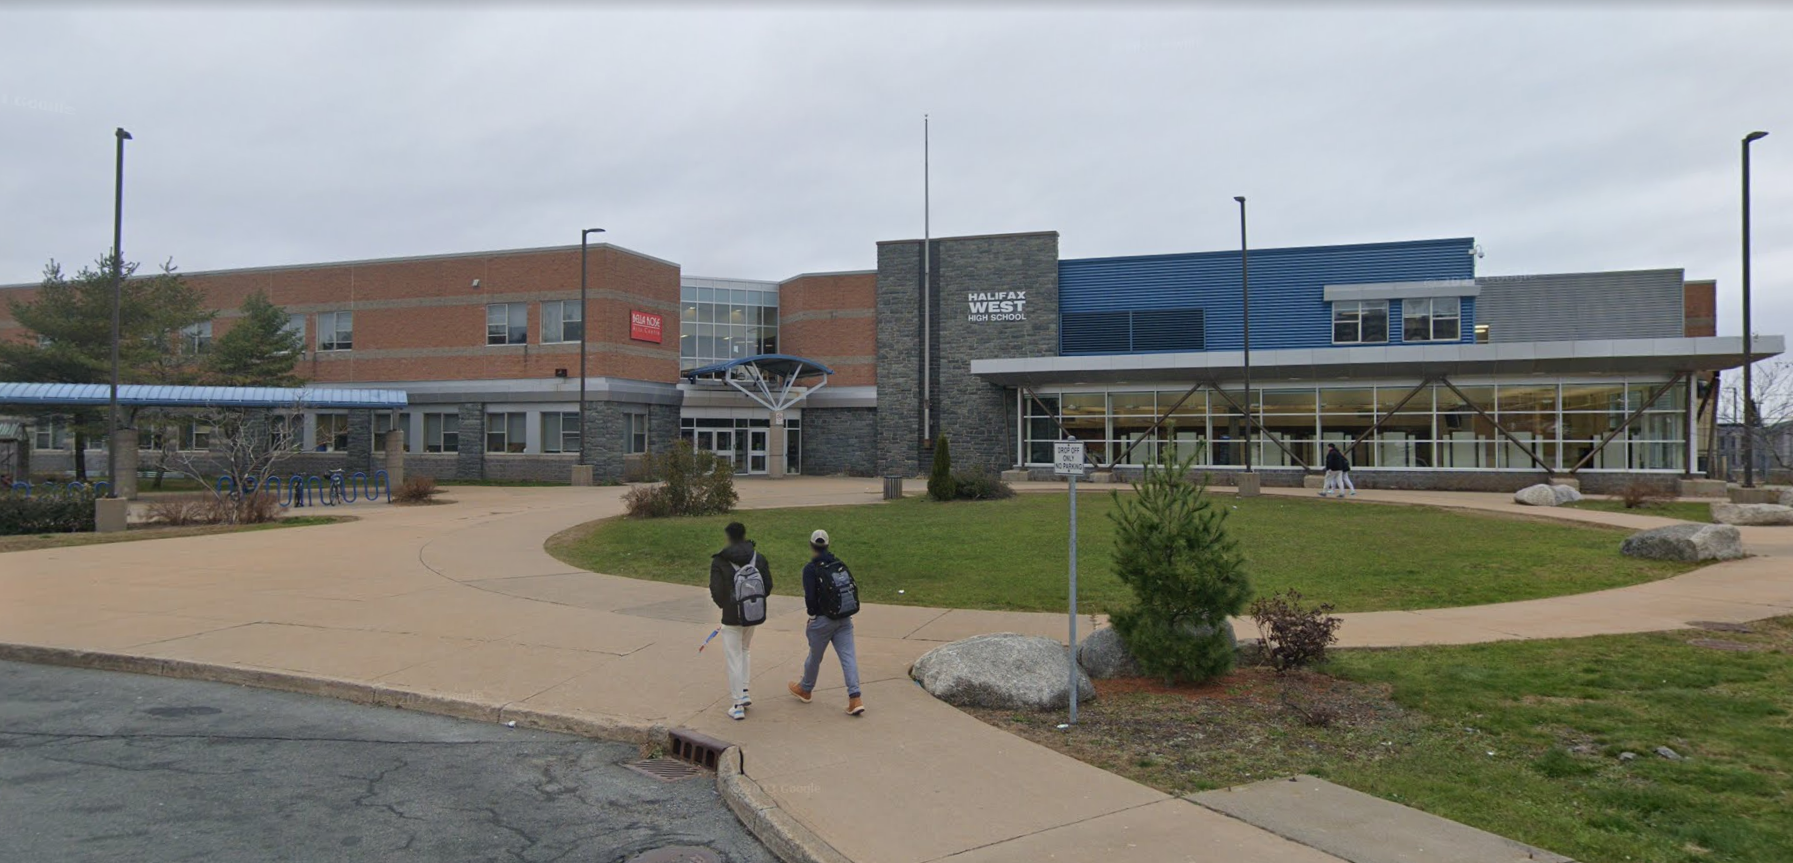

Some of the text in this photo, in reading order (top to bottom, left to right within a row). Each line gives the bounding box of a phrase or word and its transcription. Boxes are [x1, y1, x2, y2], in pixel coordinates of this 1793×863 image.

[968, 291, 1026, 301] HALIFAX
[968, 300, 1026, 313] WEST
[968, 313, 1026, 322] HIGH SCHOOL
[1057, 446, 1080, 454] DROP OFF
[1063, 454, 1074, 462] ONLY
[1055, 462, 1083, 470] NO PARKING
